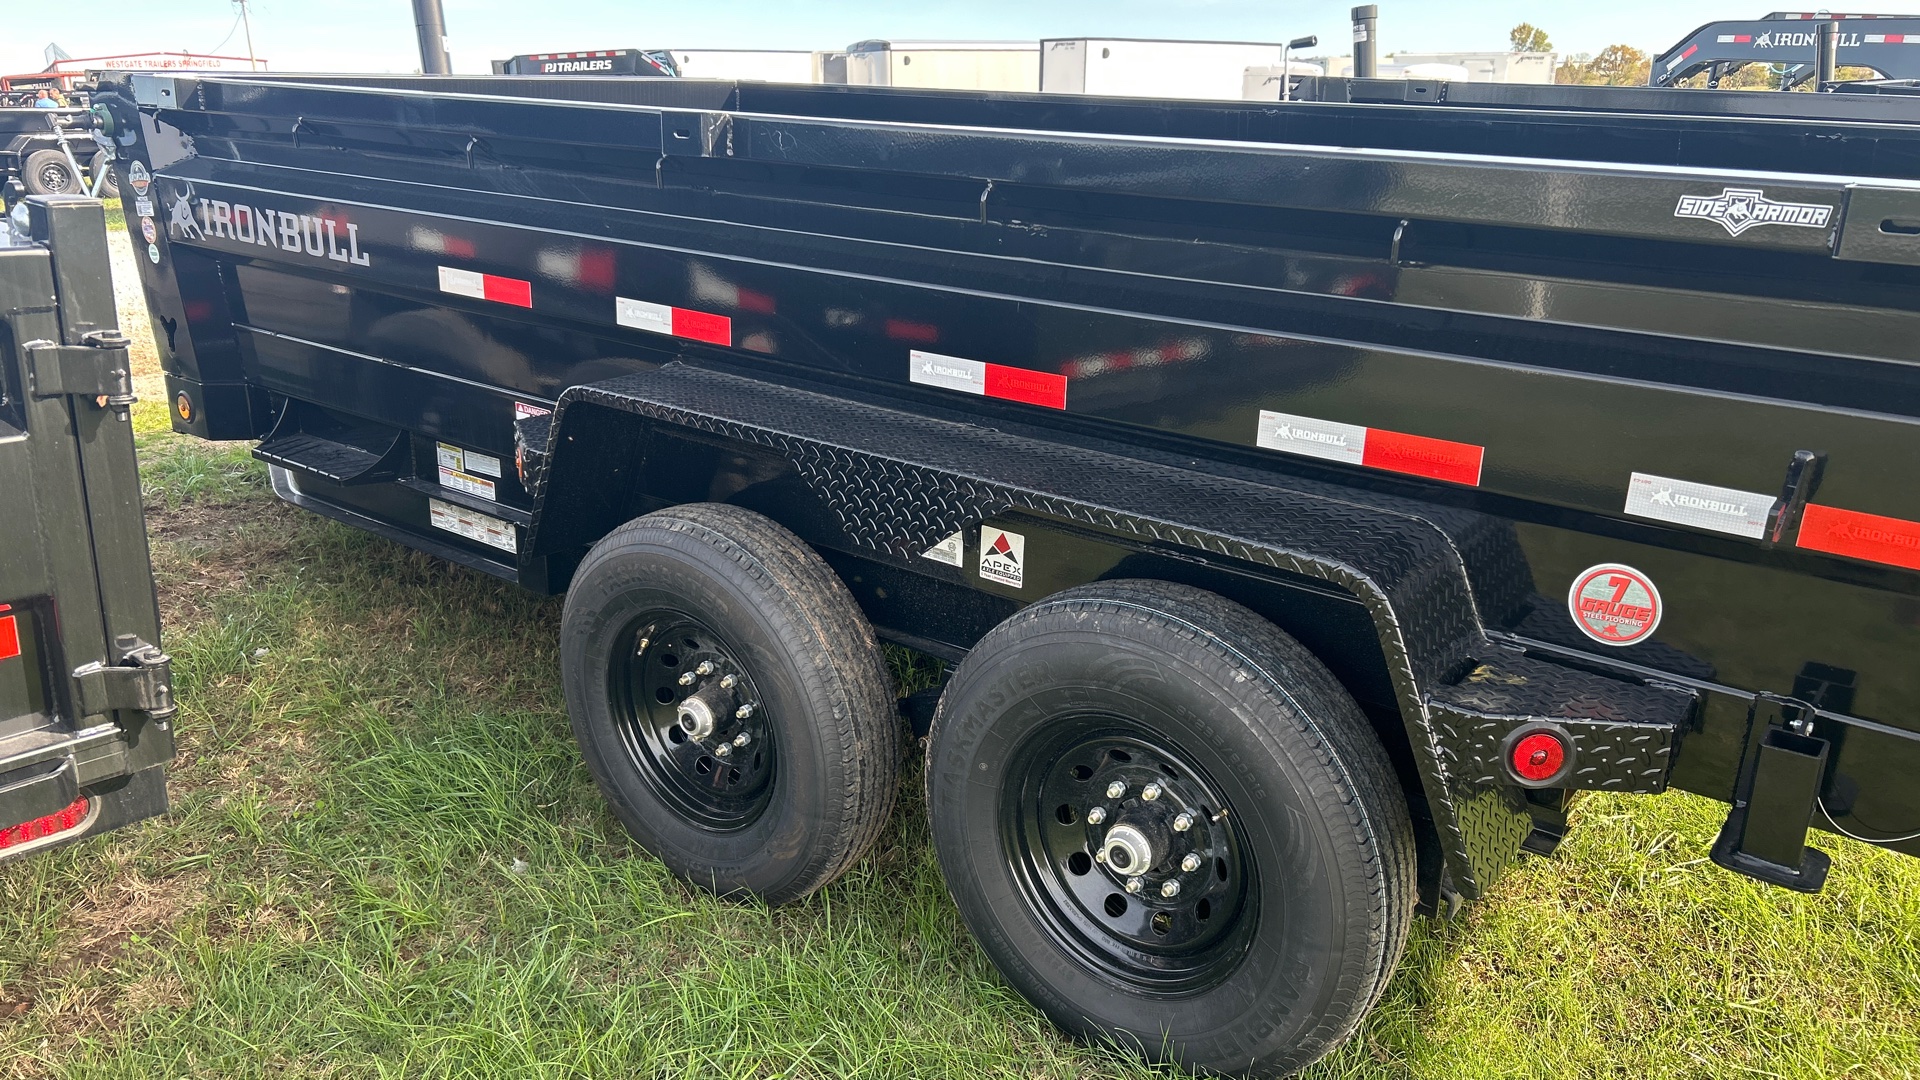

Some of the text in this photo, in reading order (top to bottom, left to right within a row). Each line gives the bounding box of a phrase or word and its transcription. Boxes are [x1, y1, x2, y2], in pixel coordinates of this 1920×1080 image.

[1773, 33, 1861, 47] IRONLL
[105, 60, 221, 68] WESTGATE TRAILERS SPRINGFIELD
[545, 60, 612, 73] PJ TRAILERS
[1679, 199, 1829, 225] SIDE ARMOR
[200, 198, 371, 267] IRONBULL
[934, 365, 972, 380] IRONBULL
[1010, 379, 1053, 394] IRONBULL
[1292, 428, 1347, 447] IRONBULL
[1401, 447, 1463, 466] IRONBULL
[1674, 493, 1748, 517] IRONBULL
[981, 558, 1022, 576] APEX
[982, 566, 1021, 581] AXLE EQUIPPED
[1608, 576, 1632, 603] 7
[1581, 597, 1652, 622] GAUGE
[1583, 611, 1643, 627] STEEL FLOORING
[939, 658, 1057, 808] TASKMASTER
[987, 926, 1026, 973] TRAILER
[1023, 971, 1068, 1014] SPECIAL
